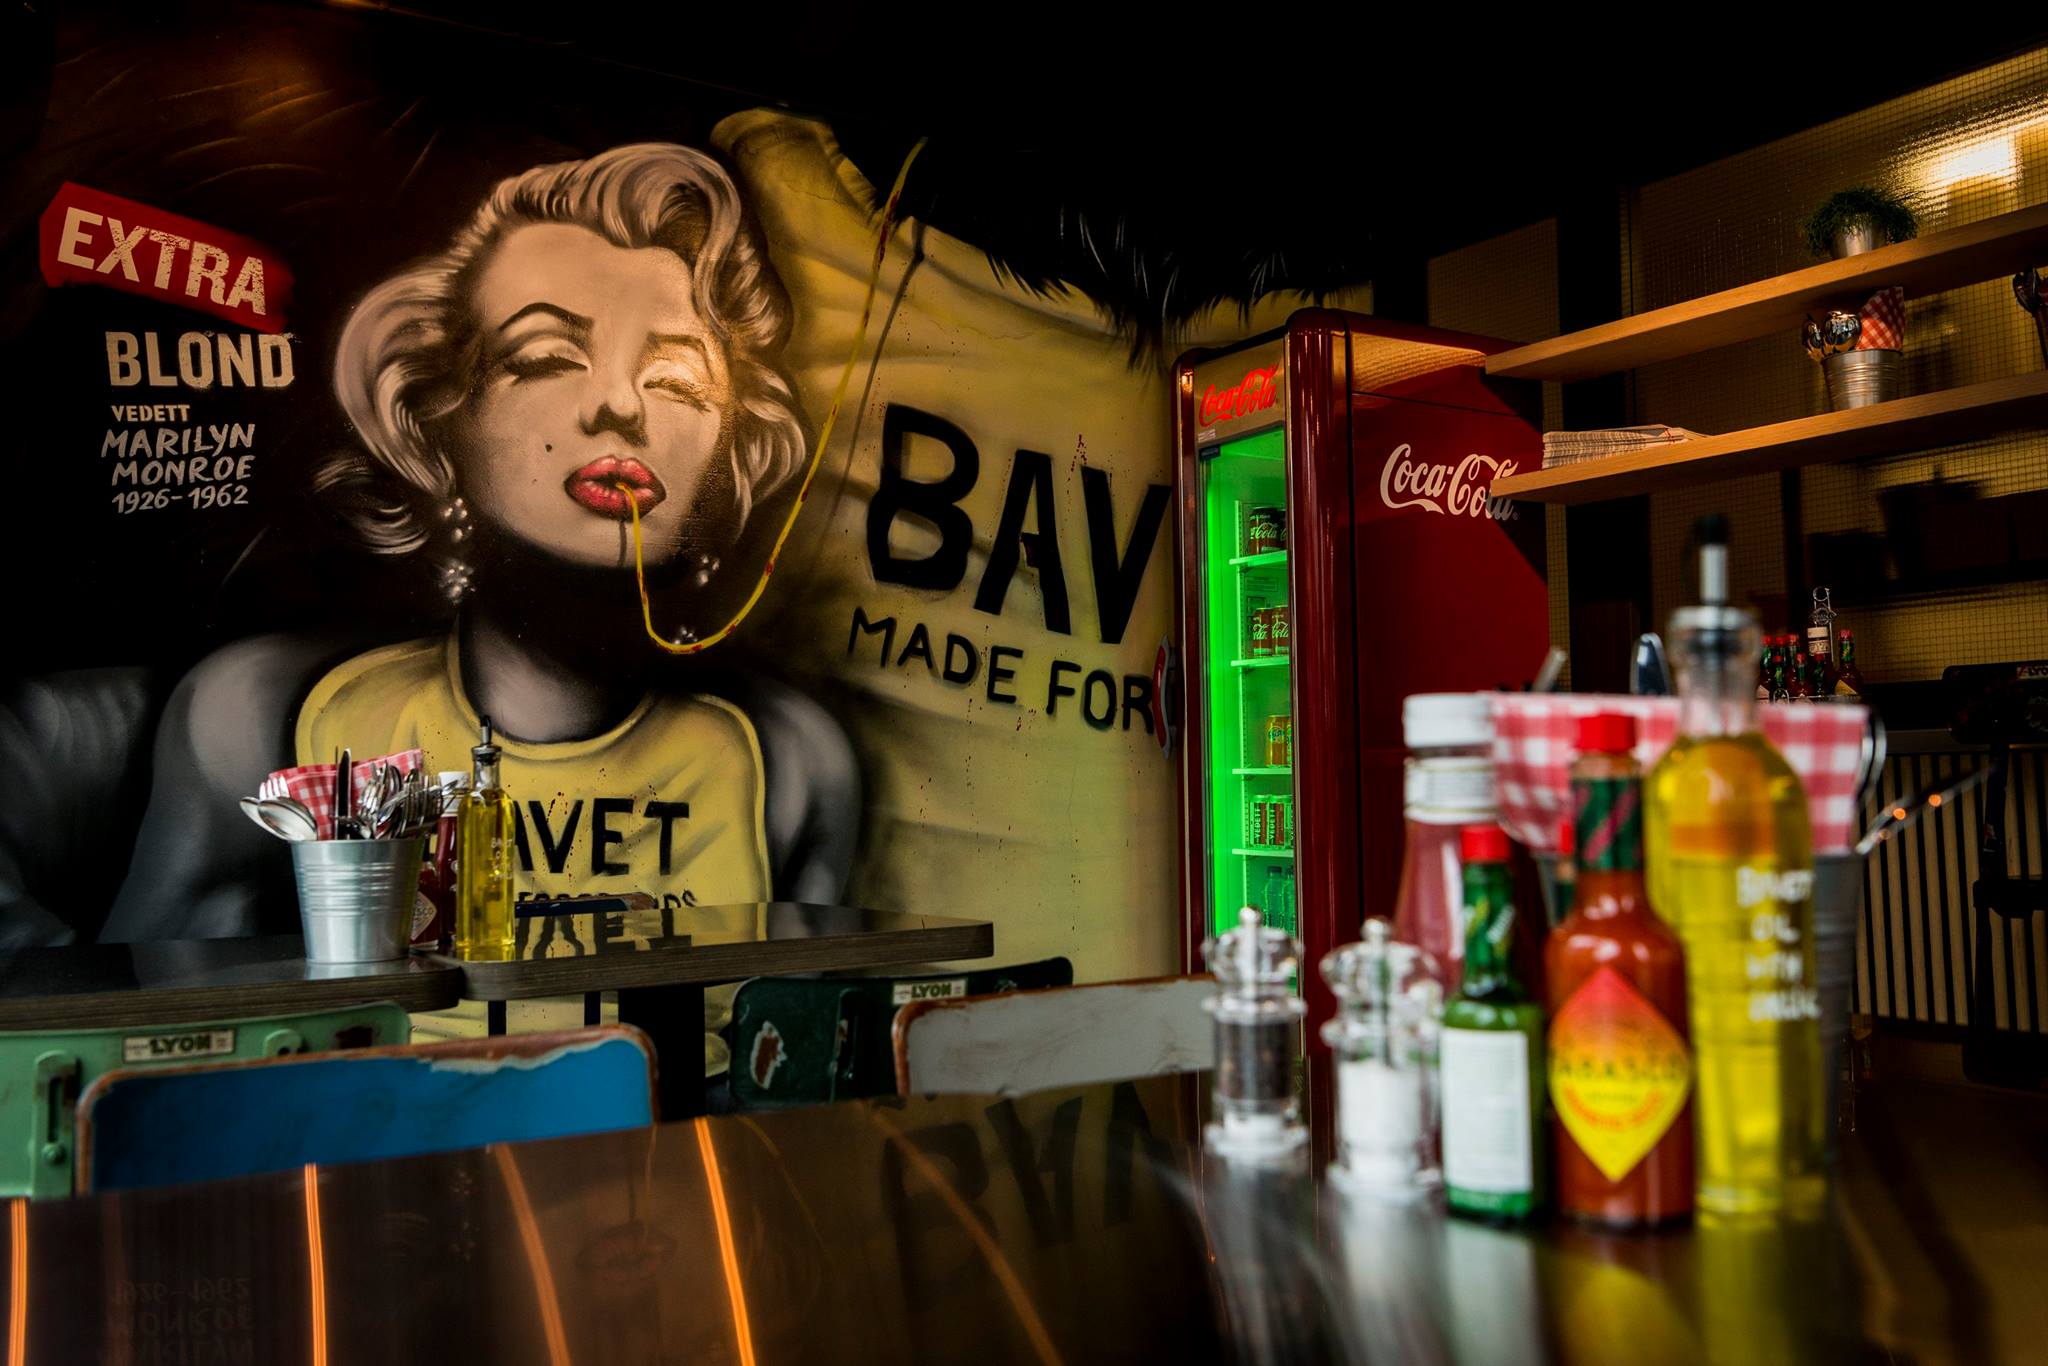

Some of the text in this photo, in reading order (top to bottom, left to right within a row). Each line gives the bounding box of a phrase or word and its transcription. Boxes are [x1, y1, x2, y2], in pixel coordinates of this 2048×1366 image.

[57, 206, 266, 316] EXTRA
[105, 331, 296, 389] BLOND
[111, 404, 190, 422] VEDETT
[101, 423, 256, 459] MARILYN
[111, 454, 256, 486] MONROE
[111, 483, 250, 514] 1926-1962
[867, 402, 1172, 645] BAV
[849, 606, 1155, 736] MADE FOR
[911, 983, 953, 998] LYON
[149, 1034, 212, 1055] LYON
